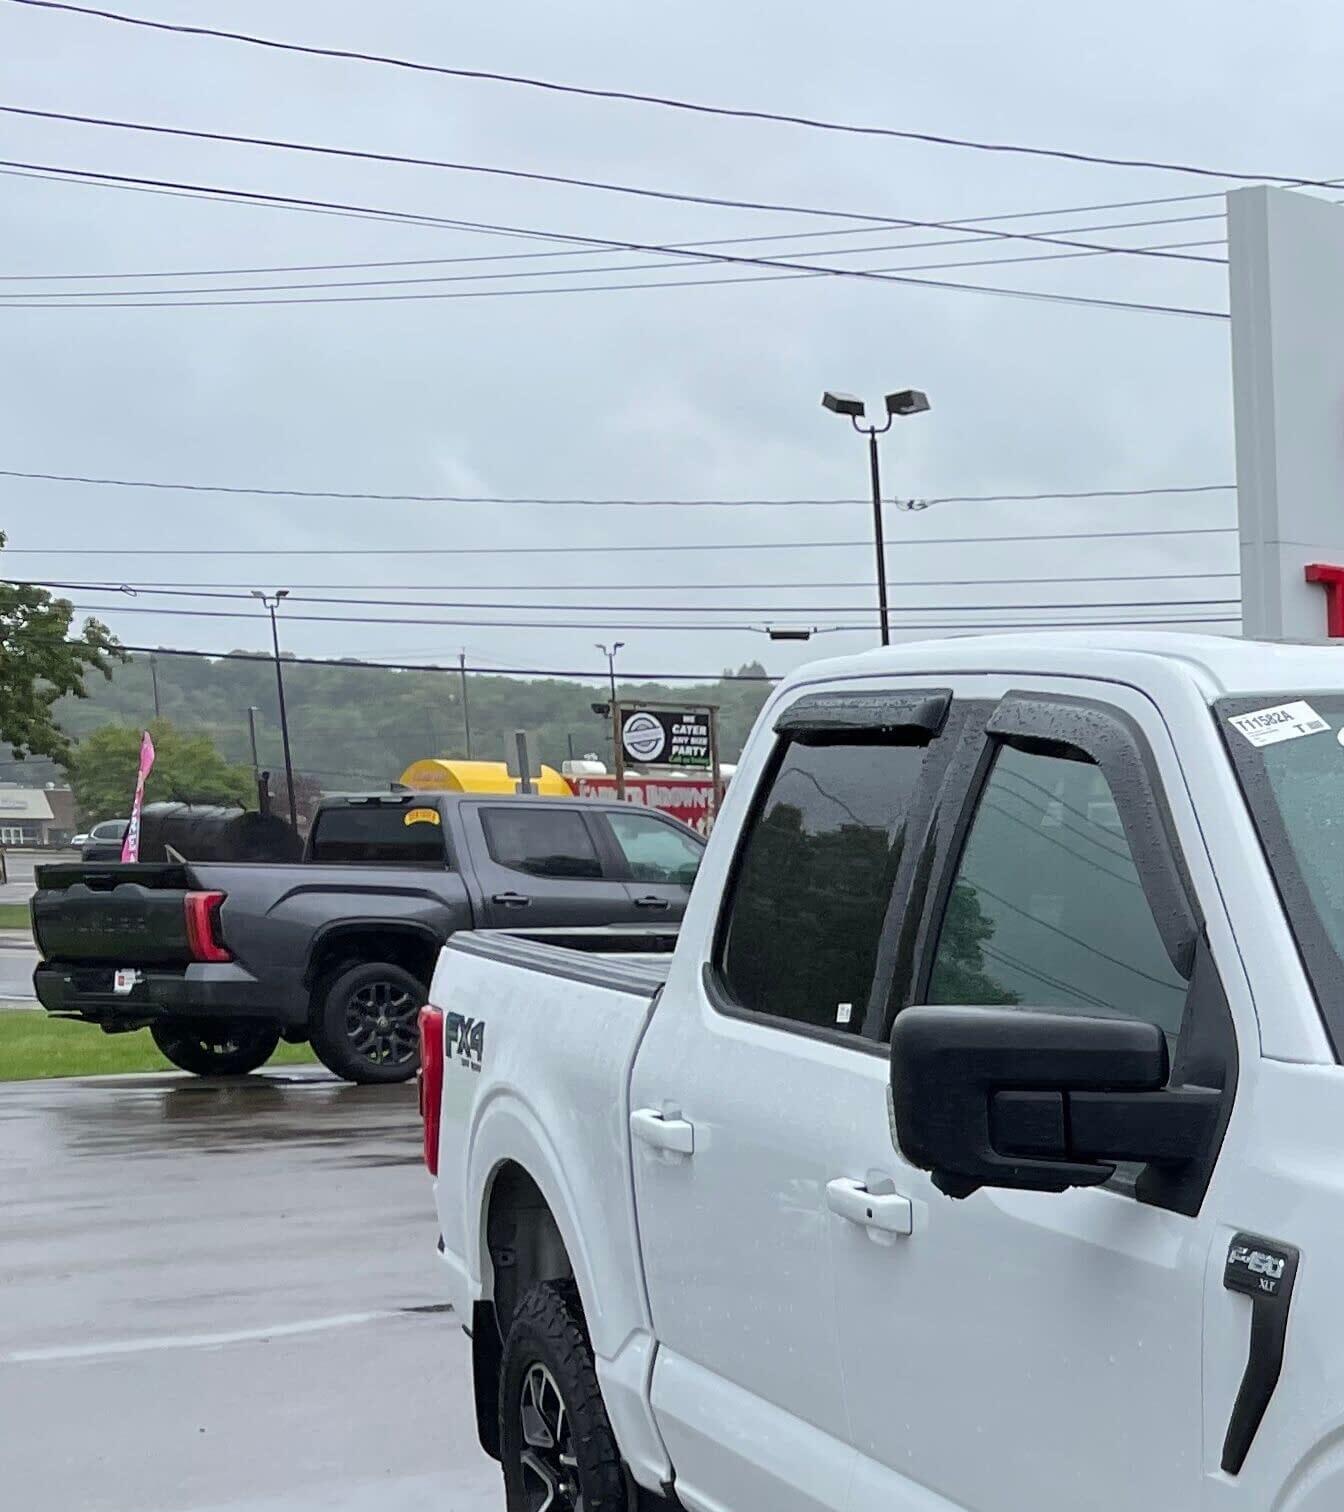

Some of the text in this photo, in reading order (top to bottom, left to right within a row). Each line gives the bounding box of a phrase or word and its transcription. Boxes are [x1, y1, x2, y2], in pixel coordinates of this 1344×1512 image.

[672, 724, 707, 736] CATER
[672, 745, 706, 757] PARTY
[445, 1011, 485, 1062] FX4
